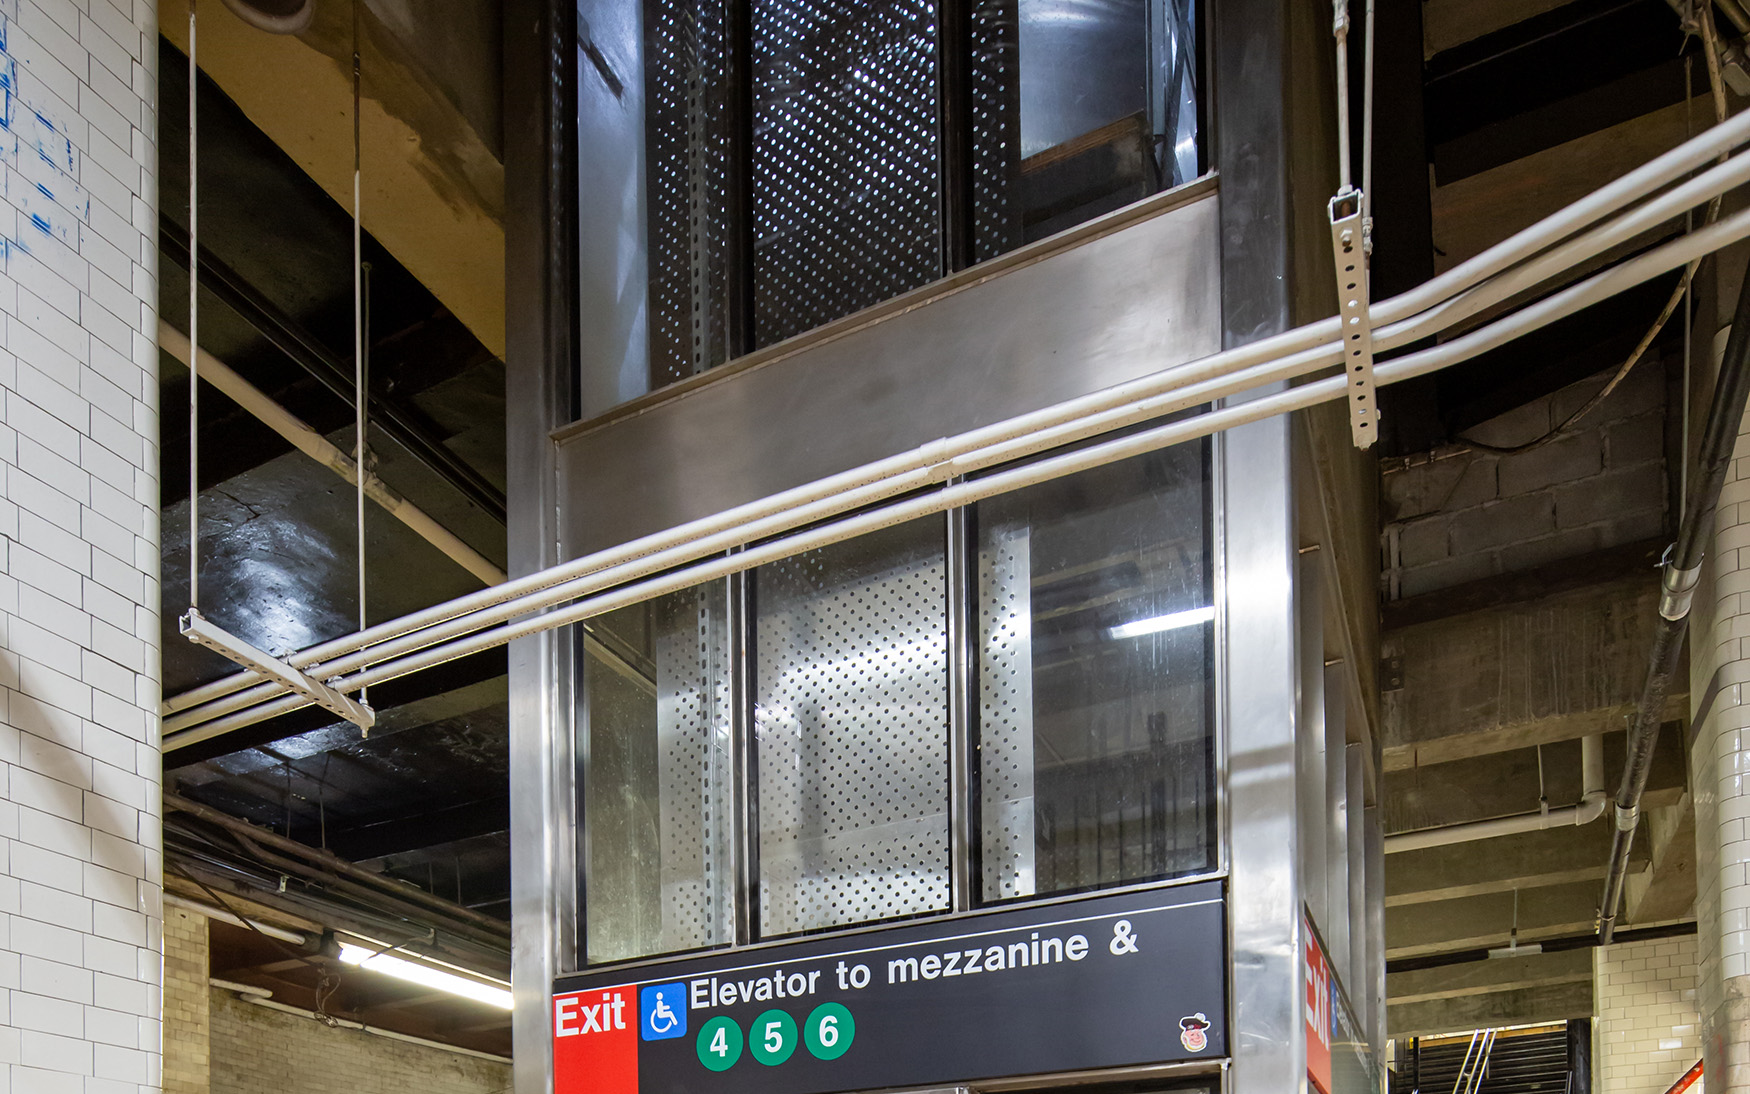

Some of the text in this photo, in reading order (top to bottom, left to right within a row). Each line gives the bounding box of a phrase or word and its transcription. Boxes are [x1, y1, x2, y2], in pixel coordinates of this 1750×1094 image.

[690, 919, 1139, 1010] Elevator to mezzanine &
[1305, 926, 1329, 1051] Exit
[555, 992, 626, 1038] Exit
[710, 1015, 839, 1058] 4 5 6
